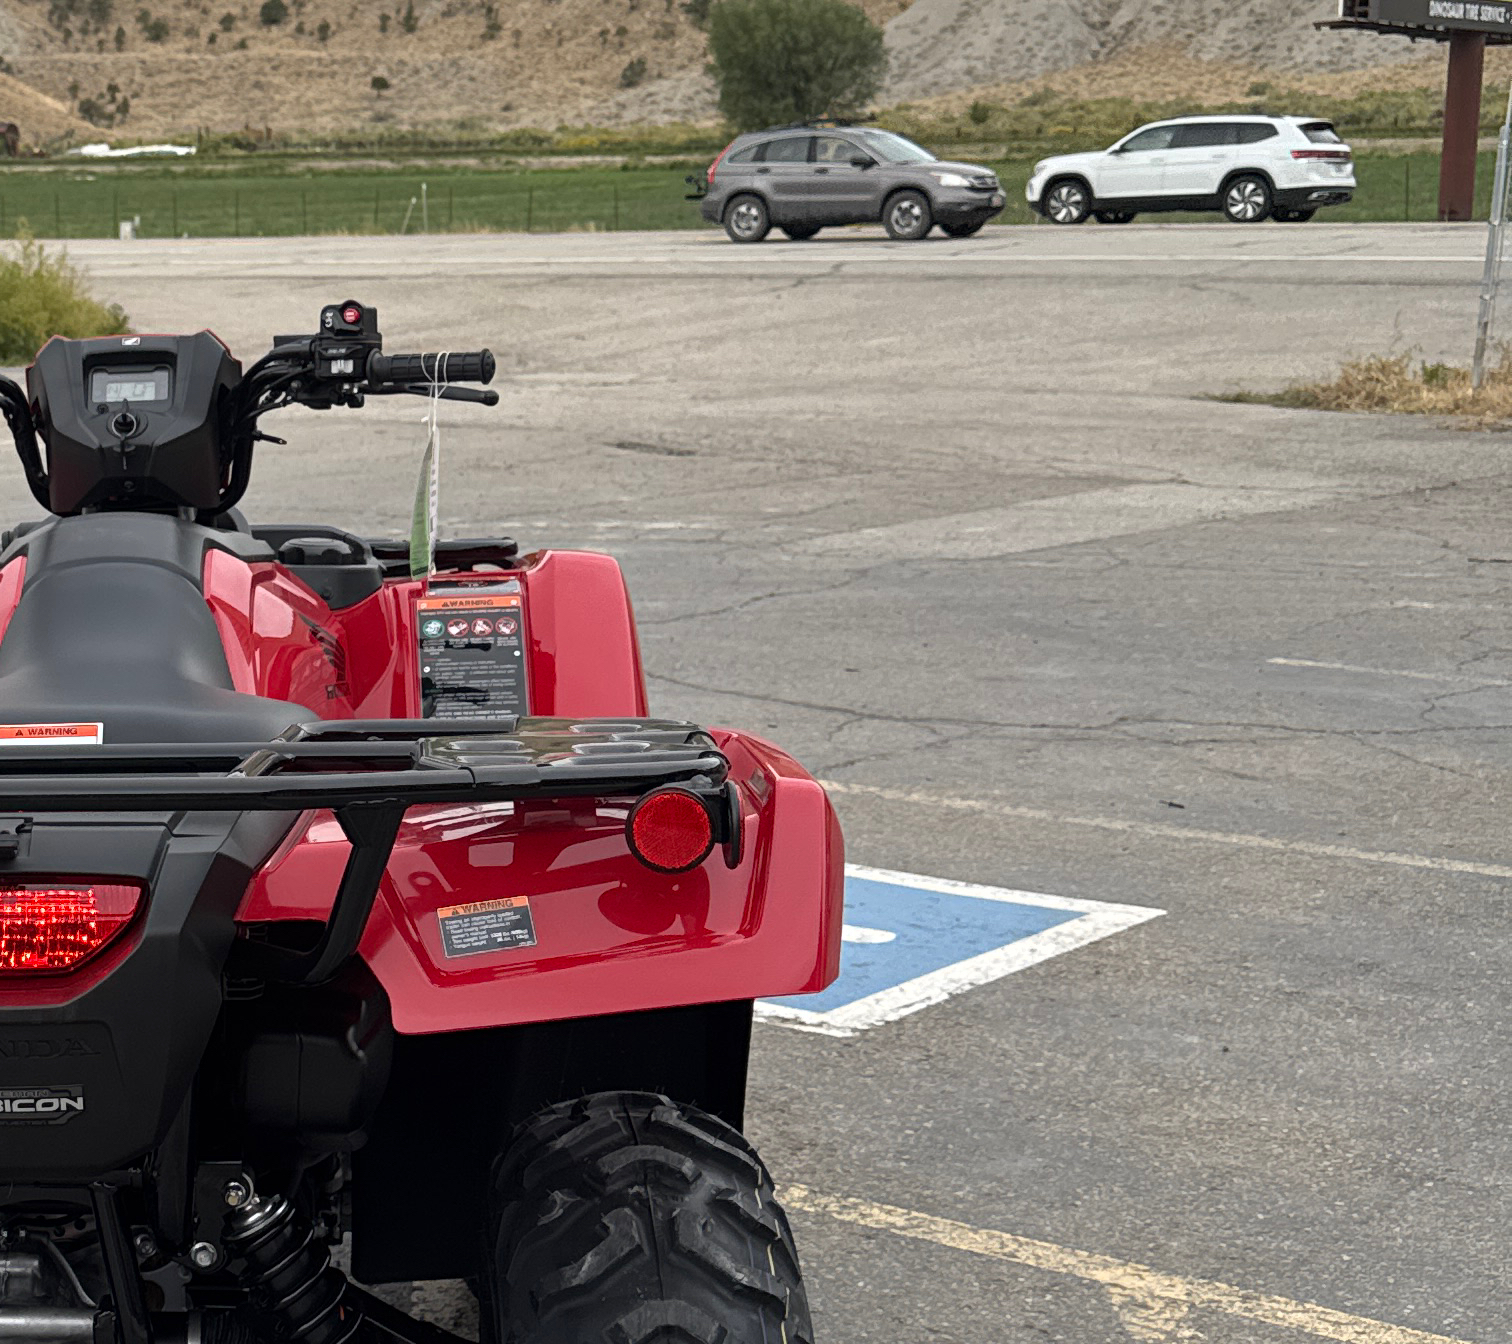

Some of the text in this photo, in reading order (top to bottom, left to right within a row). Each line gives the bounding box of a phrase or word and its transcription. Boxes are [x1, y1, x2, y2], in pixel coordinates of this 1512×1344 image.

[449, 599, 494, 608] WARNING
[28, 727, 78, 736] WARNING
[463, 899, 513, 913] WARNING
